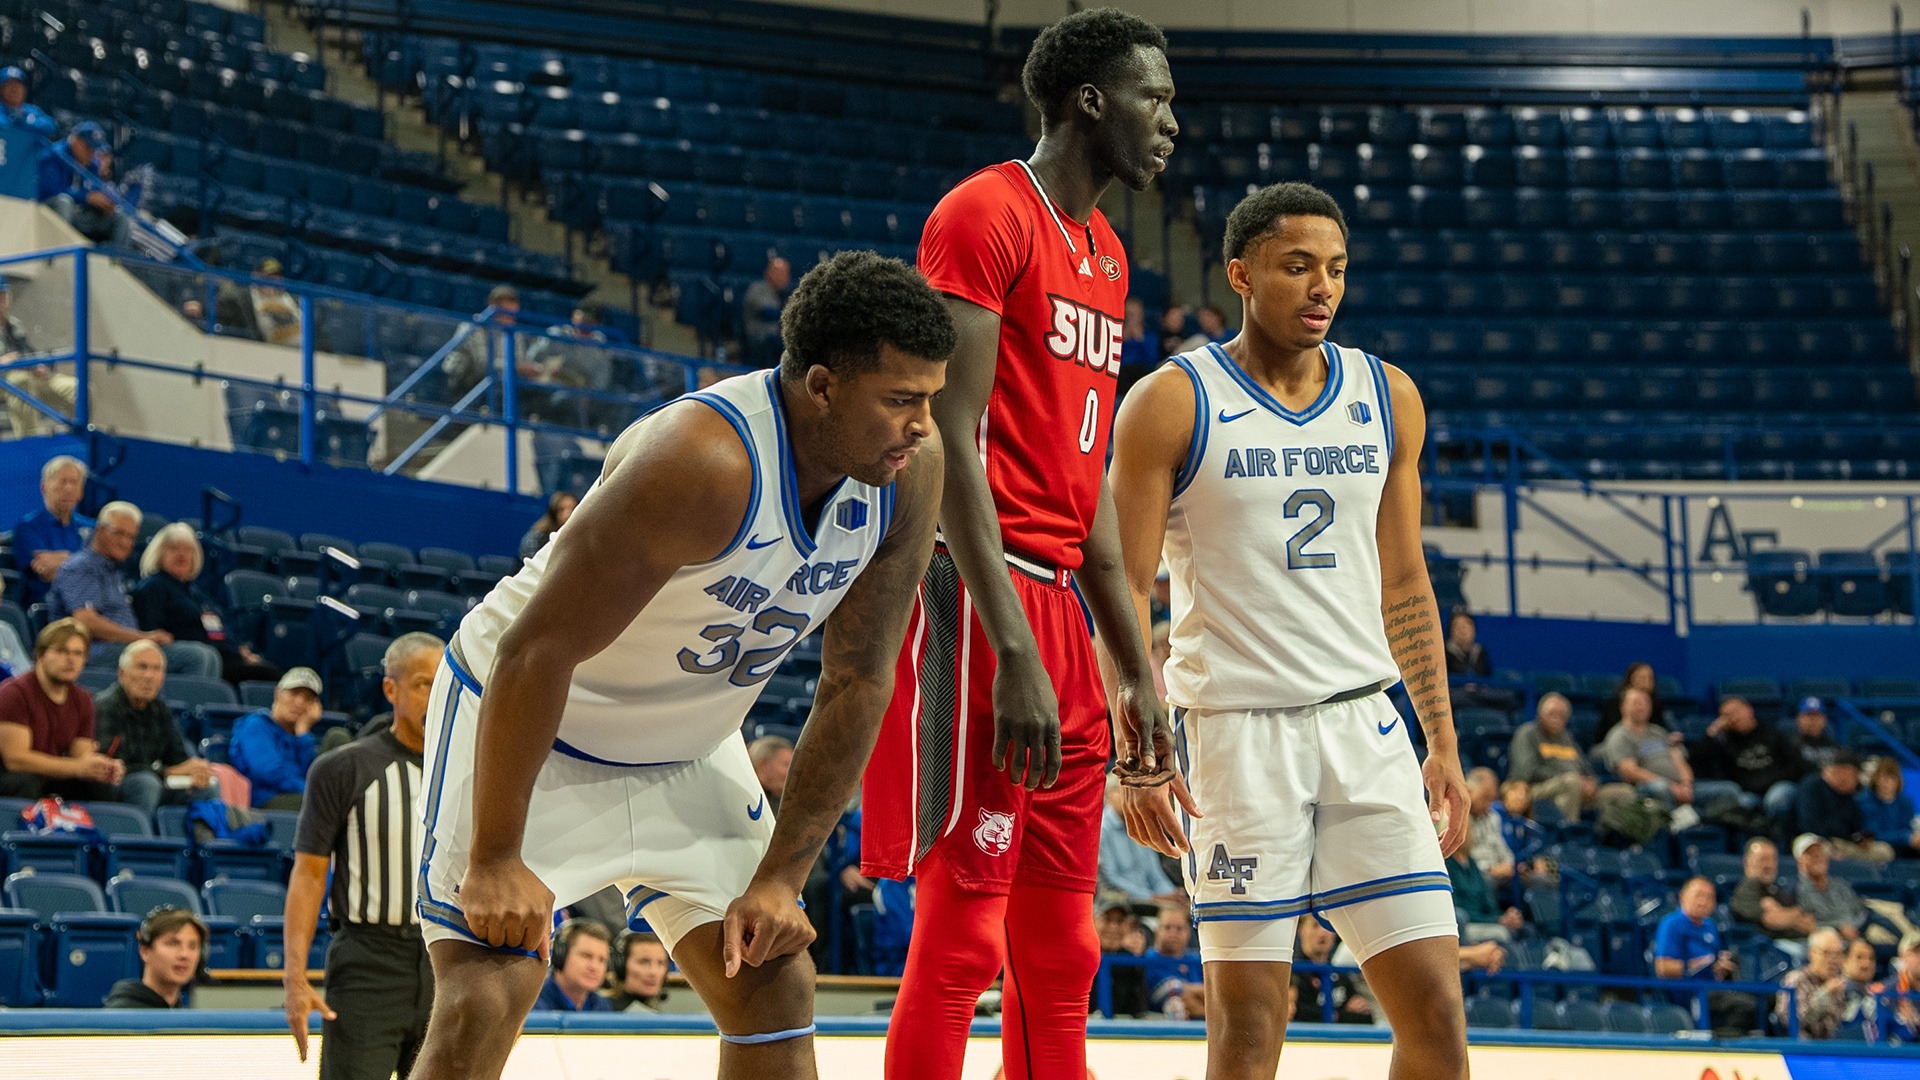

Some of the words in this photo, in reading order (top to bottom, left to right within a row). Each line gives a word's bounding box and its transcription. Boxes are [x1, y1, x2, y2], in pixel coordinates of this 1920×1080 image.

[1044, 292, 1124, 379] SIUE
[1079, 387, 1099, 455] 0
[1224, 447, 1278, 479] AIR
[1281, 444, 1380, 477] FORCE
[1283, 488, 1337, 570] 2
[703, 575, 771, 614] AIR
[676, 605, 811, 687] 32
[1207, 844, 1258, 895] AF
